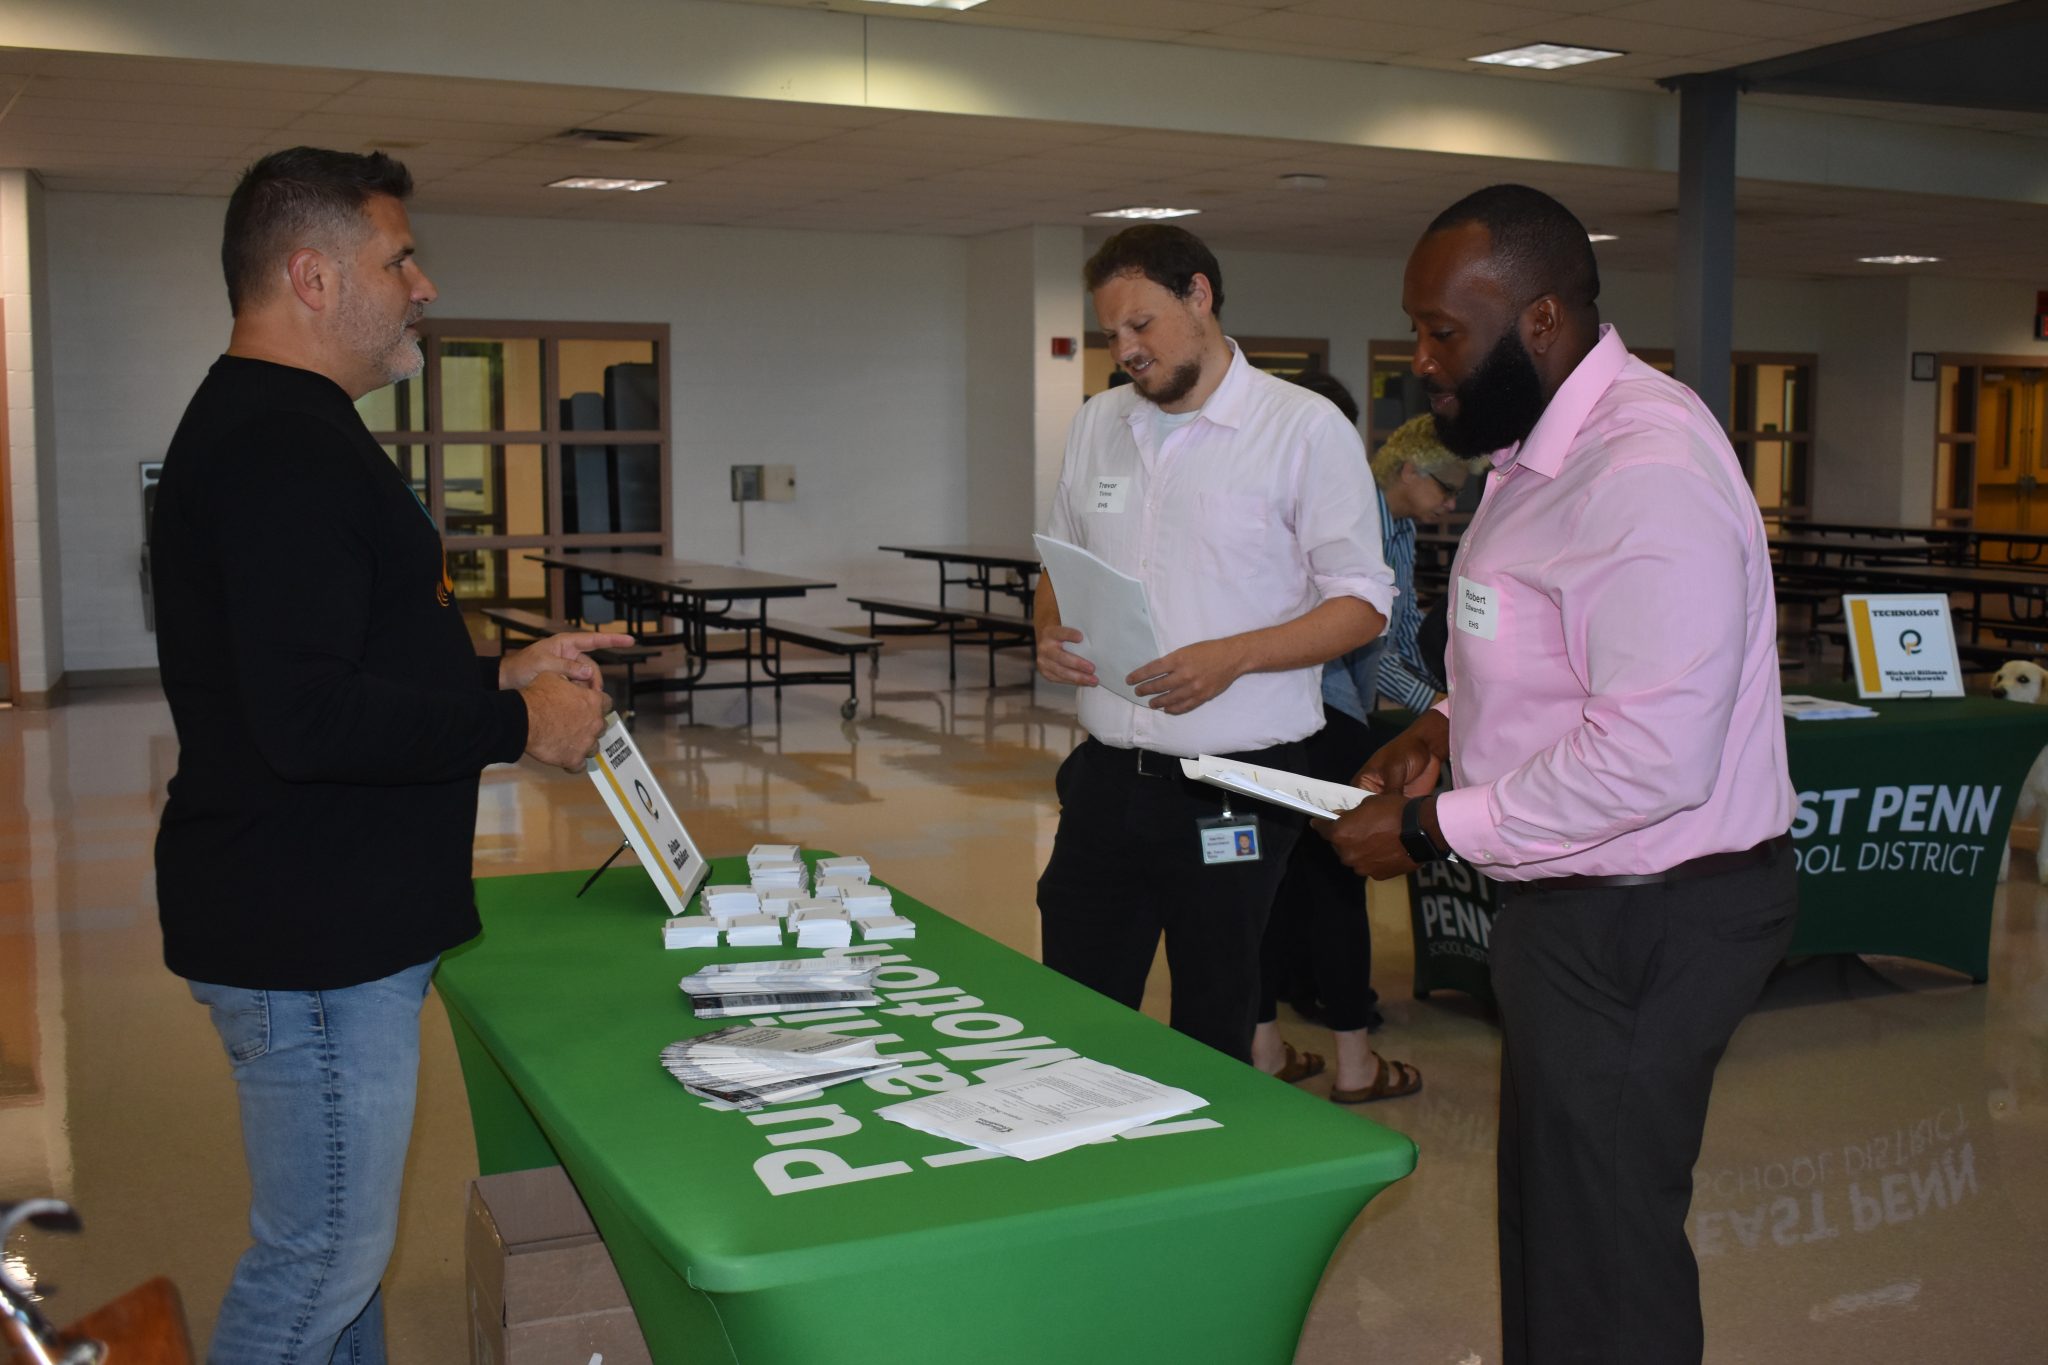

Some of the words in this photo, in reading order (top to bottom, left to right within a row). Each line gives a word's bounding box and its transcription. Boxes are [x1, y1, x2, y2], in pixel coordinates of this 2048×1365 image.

[1465, 589, 1486, 605] Robert
[1871, 609, 1941, 617] TECHNOLOGY
[1867, 784, 2002, 836] PENN
[1857, 841, 1985, 877] DISTRICT
